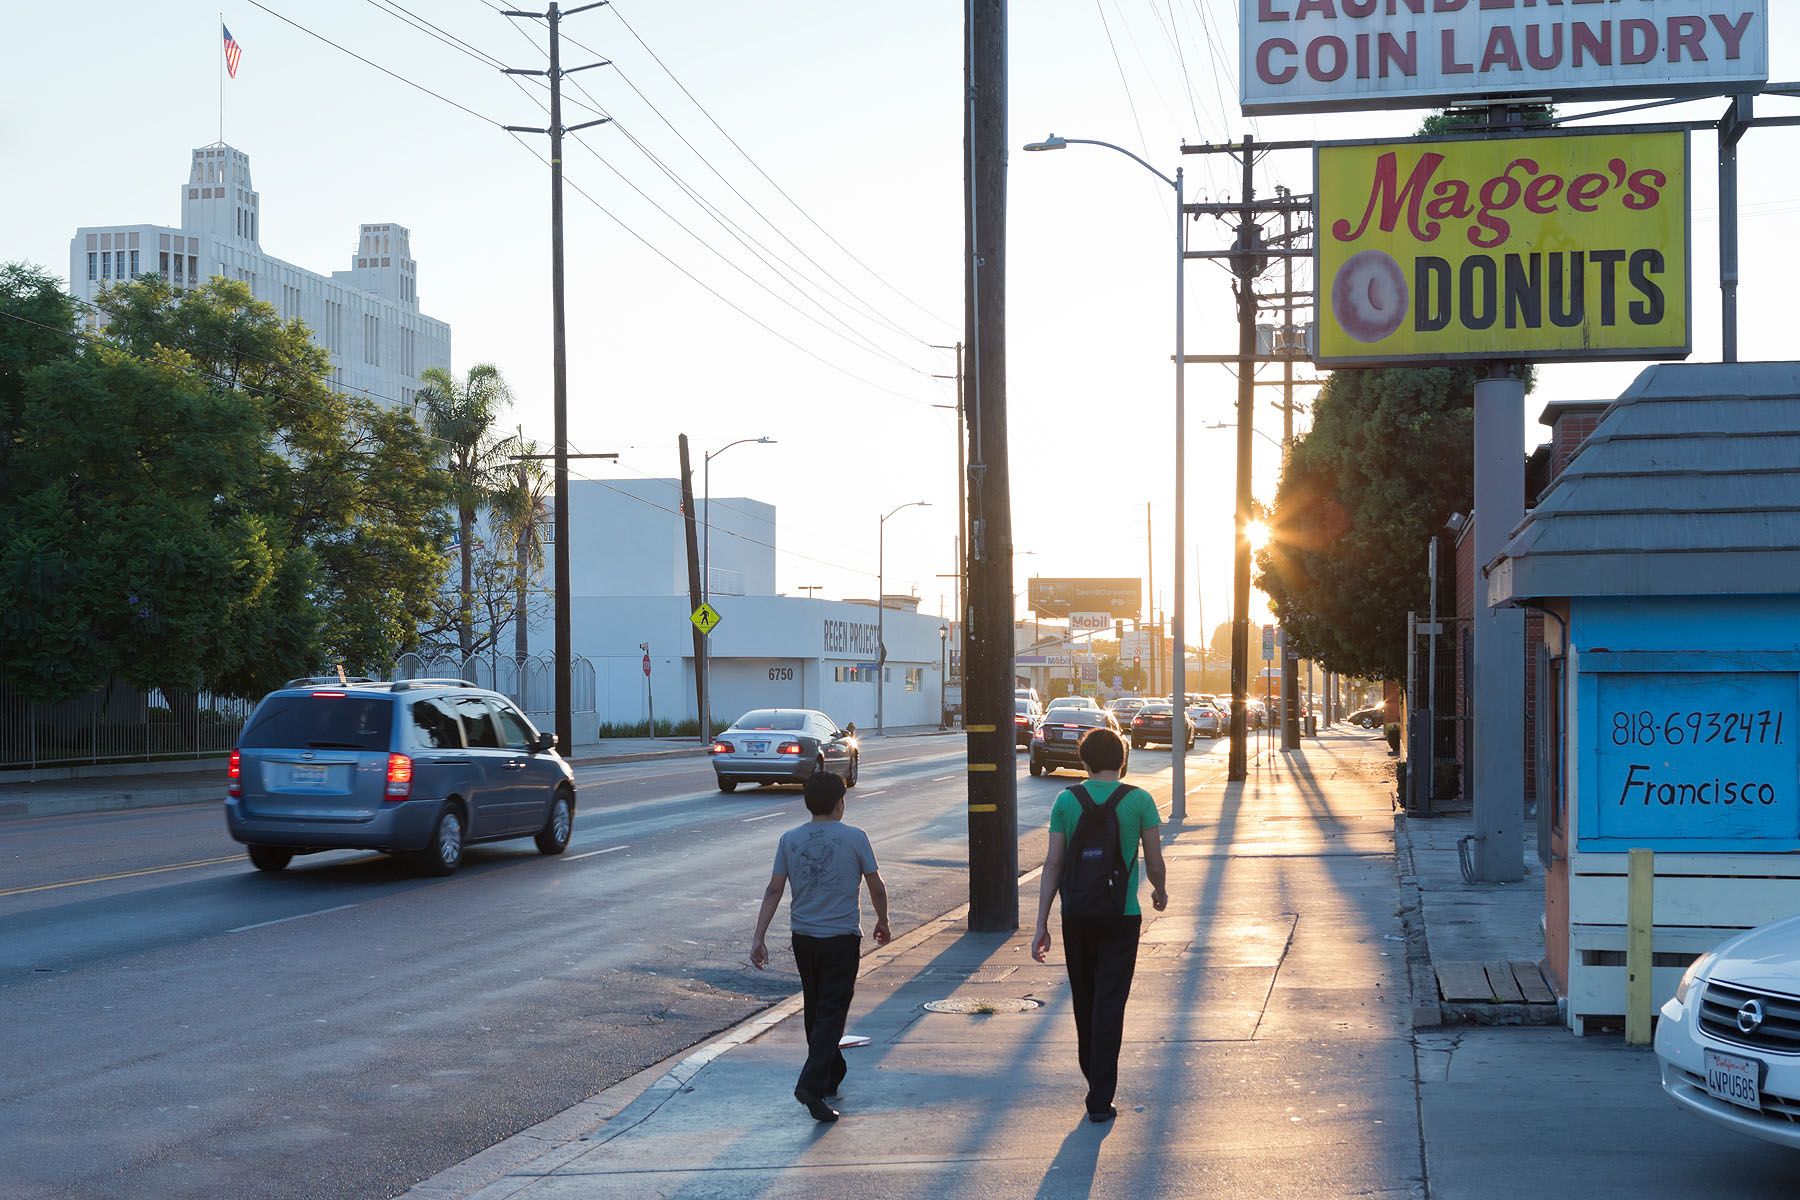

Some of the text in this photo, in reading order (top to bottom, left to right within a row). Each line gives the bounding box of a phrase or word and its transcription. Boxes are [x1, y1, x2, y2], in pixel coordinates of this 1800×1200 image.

[1256, 12, 1753, 84] COIN LAUNDRY
[1332, 151, 1667, 247] Magee's
[1414, 249, 1665, 331] DONUTS
[824, 619, 848, 652] REGEN
[1072, 615, 1107, 628] Mobil
[768, 667, 793, 680] 6750
[1709, 1069, 1755, 1101] 4VPU585
